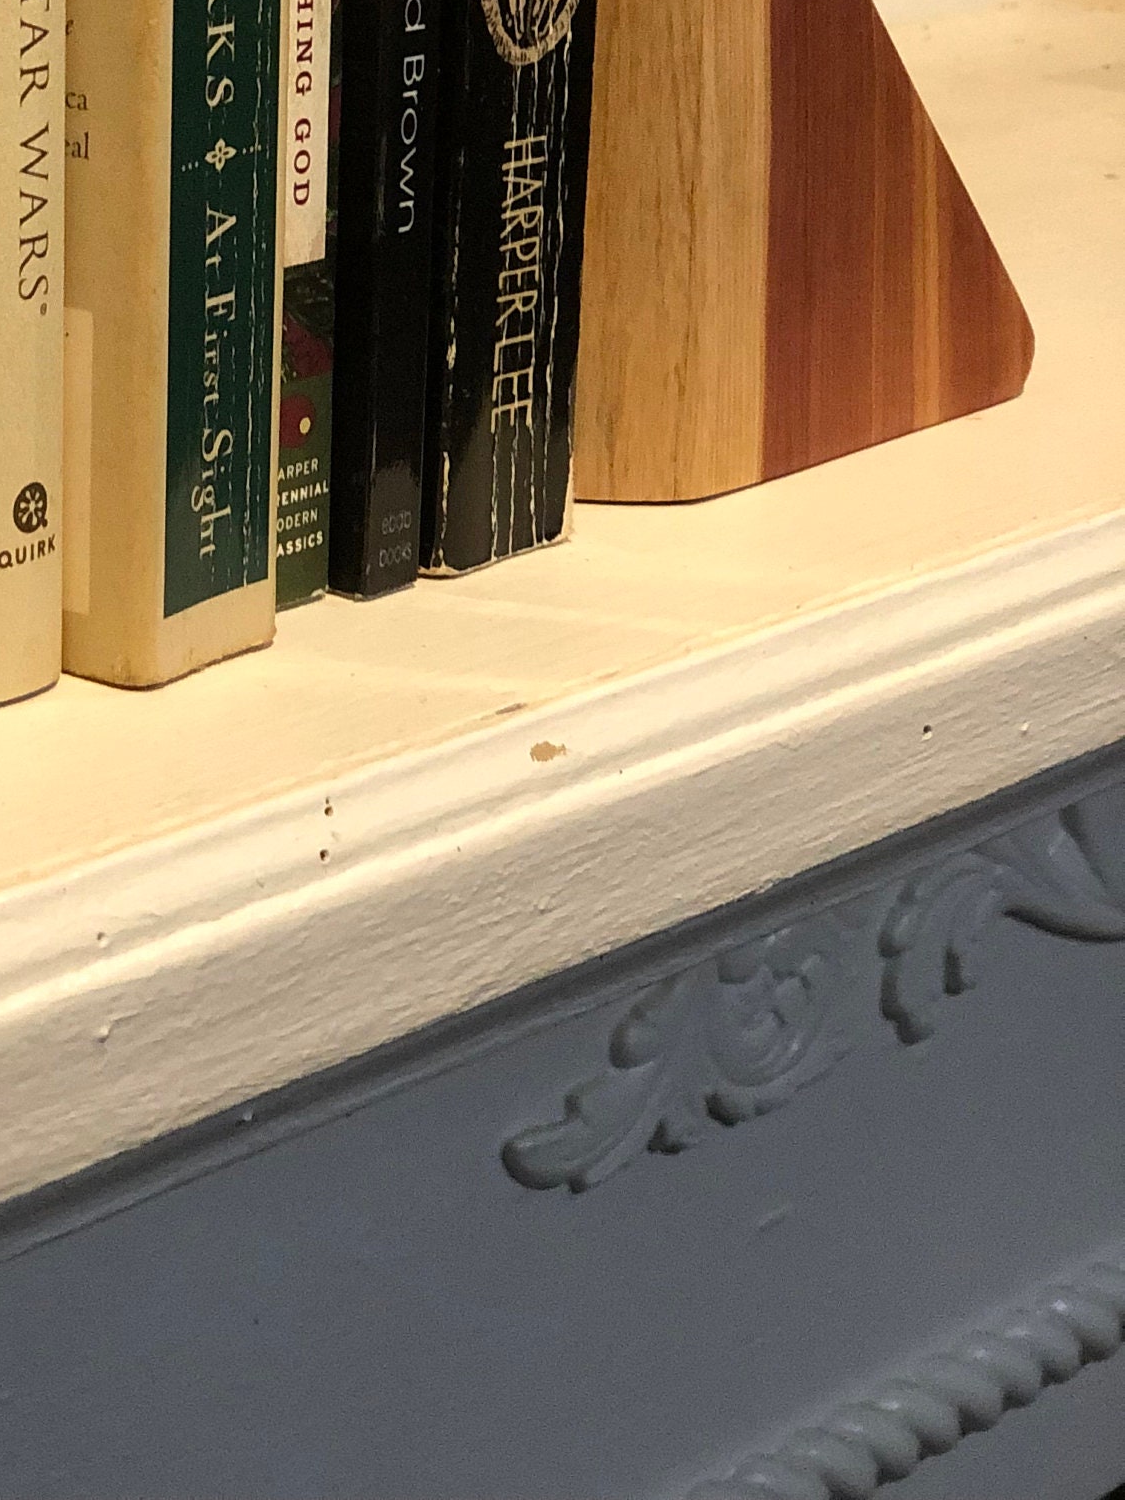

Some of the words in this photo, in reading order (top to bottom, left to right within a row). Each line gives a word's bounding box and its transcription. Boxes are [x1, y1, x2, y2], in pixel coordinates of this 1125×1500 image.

[293, 117, 312, 206] GOD
[398, 54, 425, 235] Brown
[204, 202, 236, 267] At
[495, 134, 547, 328] HARPER
[202, 287, 236, 407] First
[490, 333, 534, 434] LEE
[191, 427, 232, 558] Sight
[277, 480, 329, 506] ENNIAL
[278, 458, 319, 481] ARPER
[276, 531, 323, 558] ASSICS
[277, 508, 318, 533] ODERN
